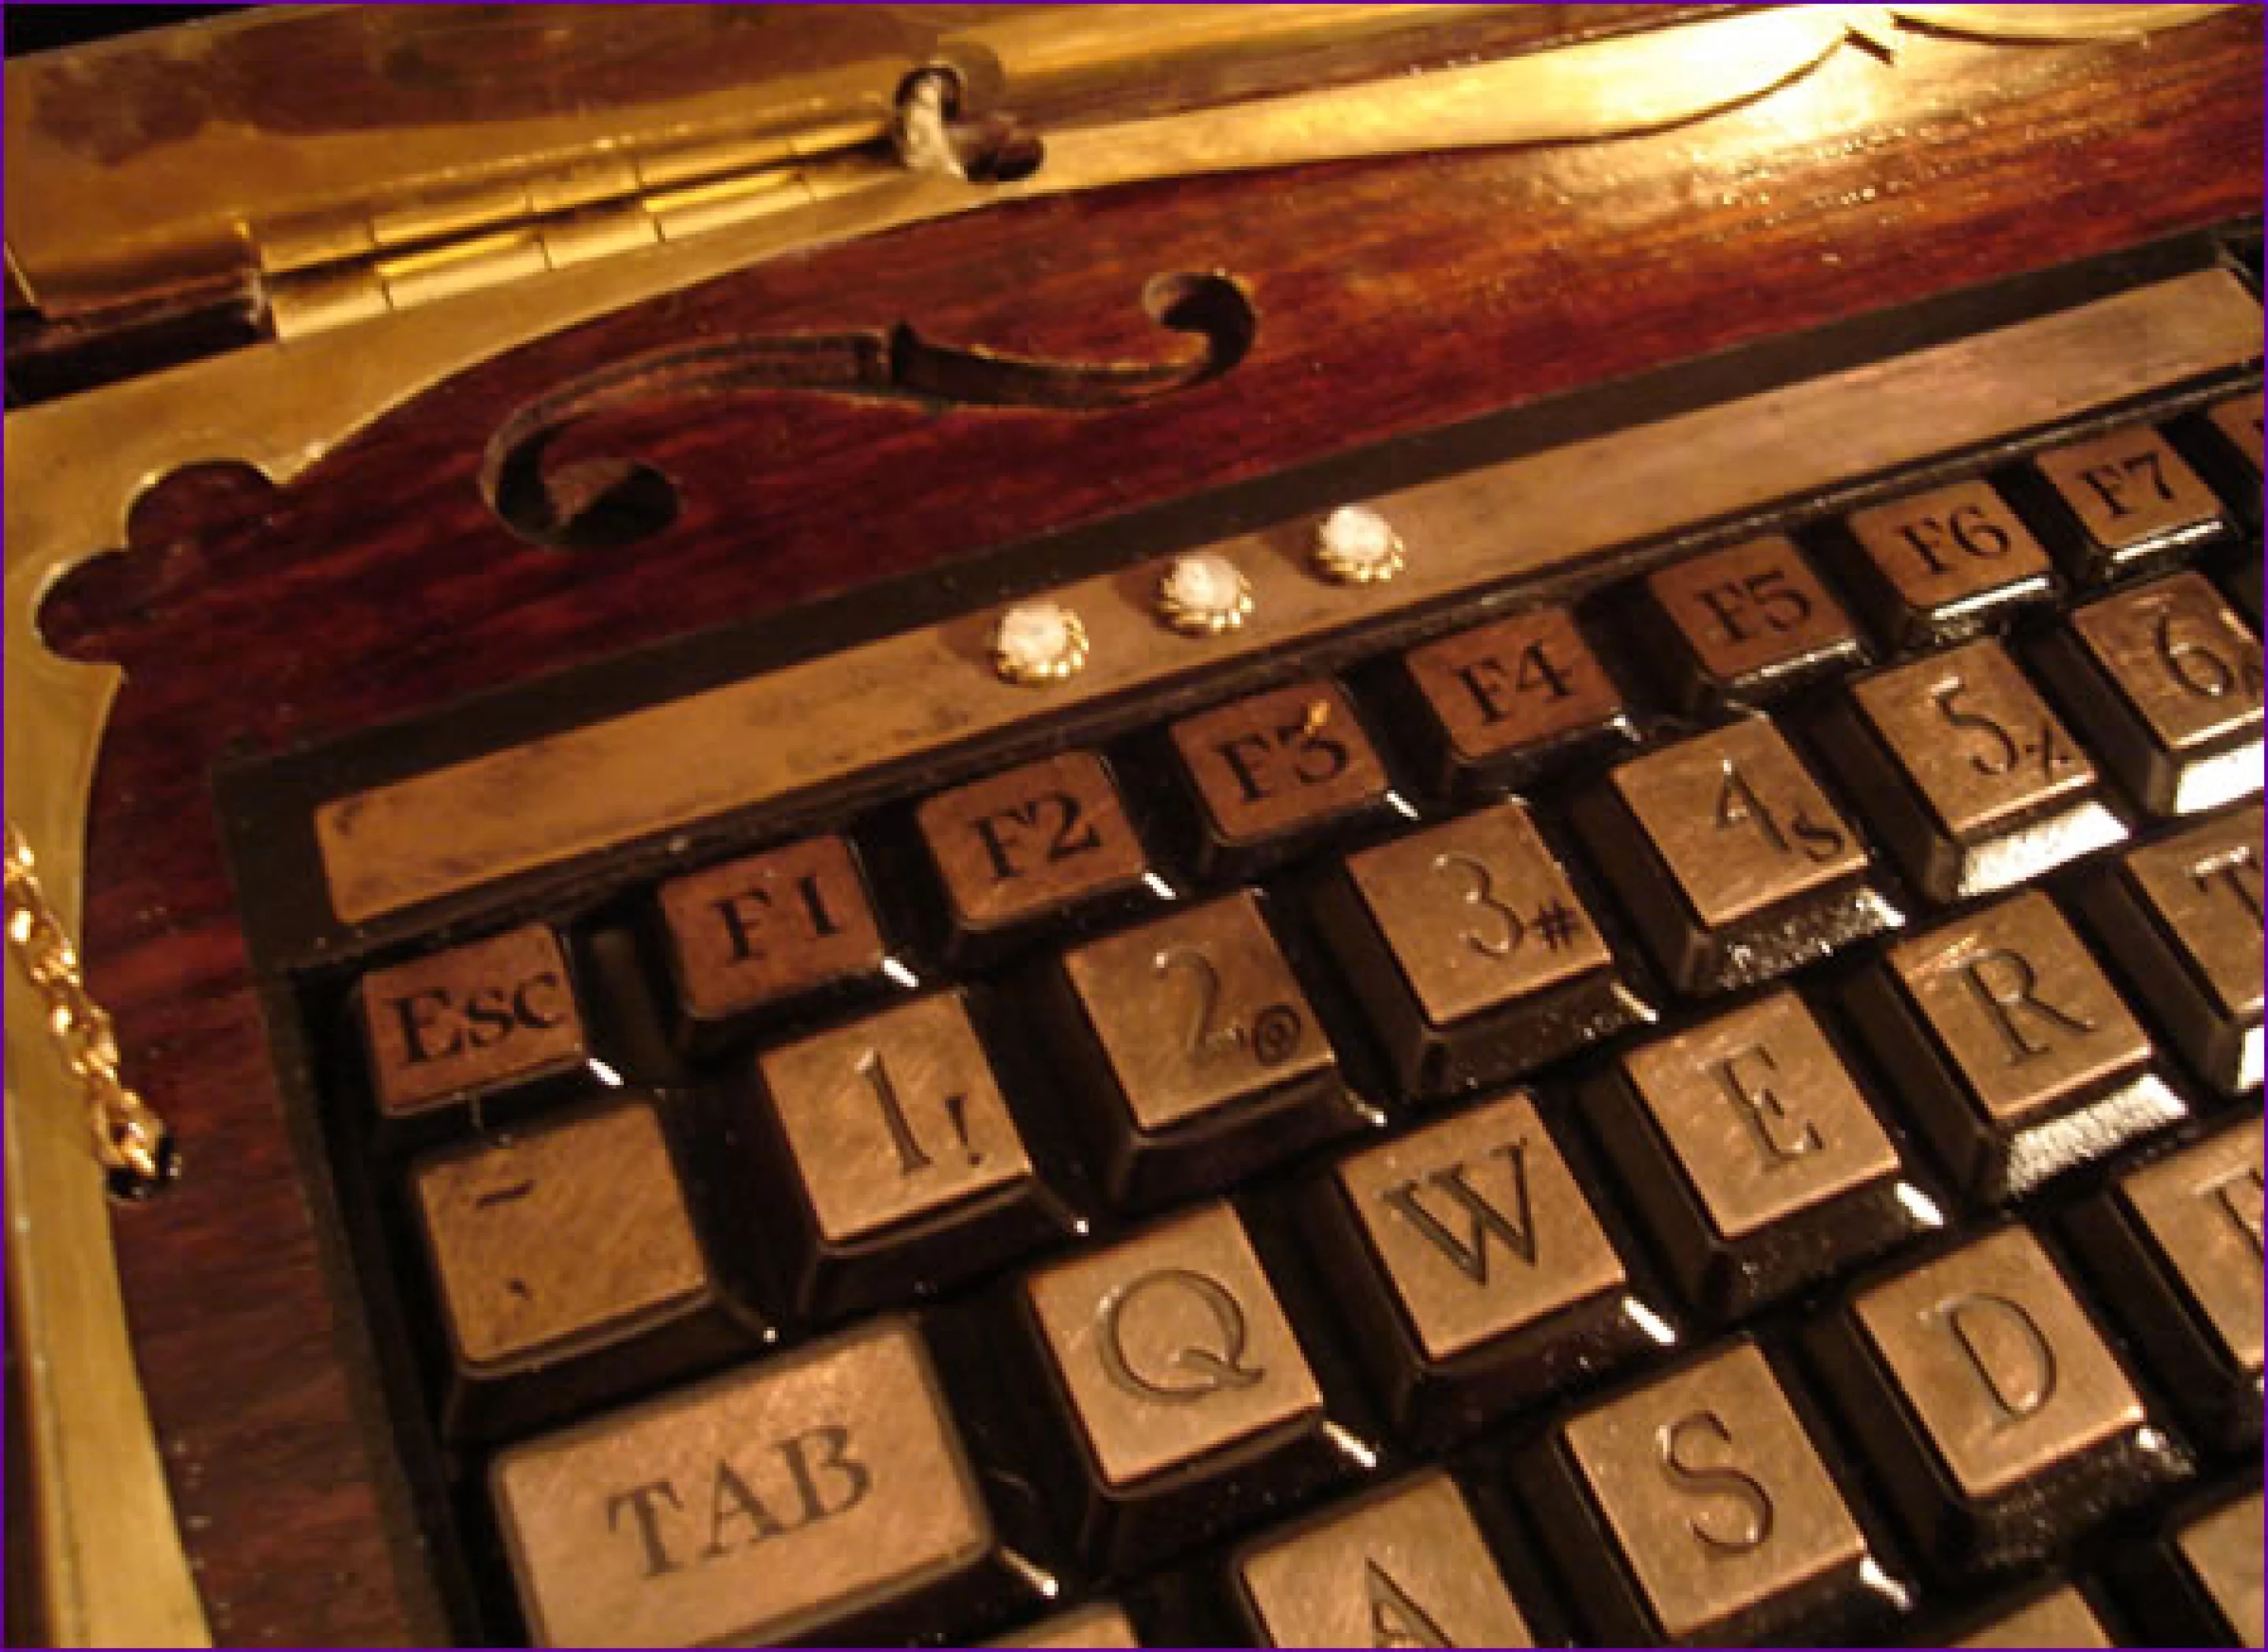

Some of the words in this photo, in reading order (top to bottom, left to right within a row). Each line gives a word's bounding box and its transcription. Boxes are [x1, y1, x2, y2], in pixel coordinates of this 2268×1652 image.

[2081, 450, 2175, 520] F7
[1896, 502, 2010, 576] F6
[1693, 567, 1813, 644] F5
[1451, 639, 1573, 725] F4
[1216, 717, 1349, 803] F3
[969, 791, 1102, 881] F2
[713, 874, 839, 961] F1
[391, 970, 569, 1065] Esc
[1942, 945, 2098, 1066] R
[1696, 1041, 1824, 1173] E
[1378, 1138, 1538, 1289] W
[1097, 1268, 1265, 1405] Q
[1918, 1292, 2058, 1435] D
[606, 1422, 873, 1578] TAB
[1655, 1409, 1774, 1554] S
